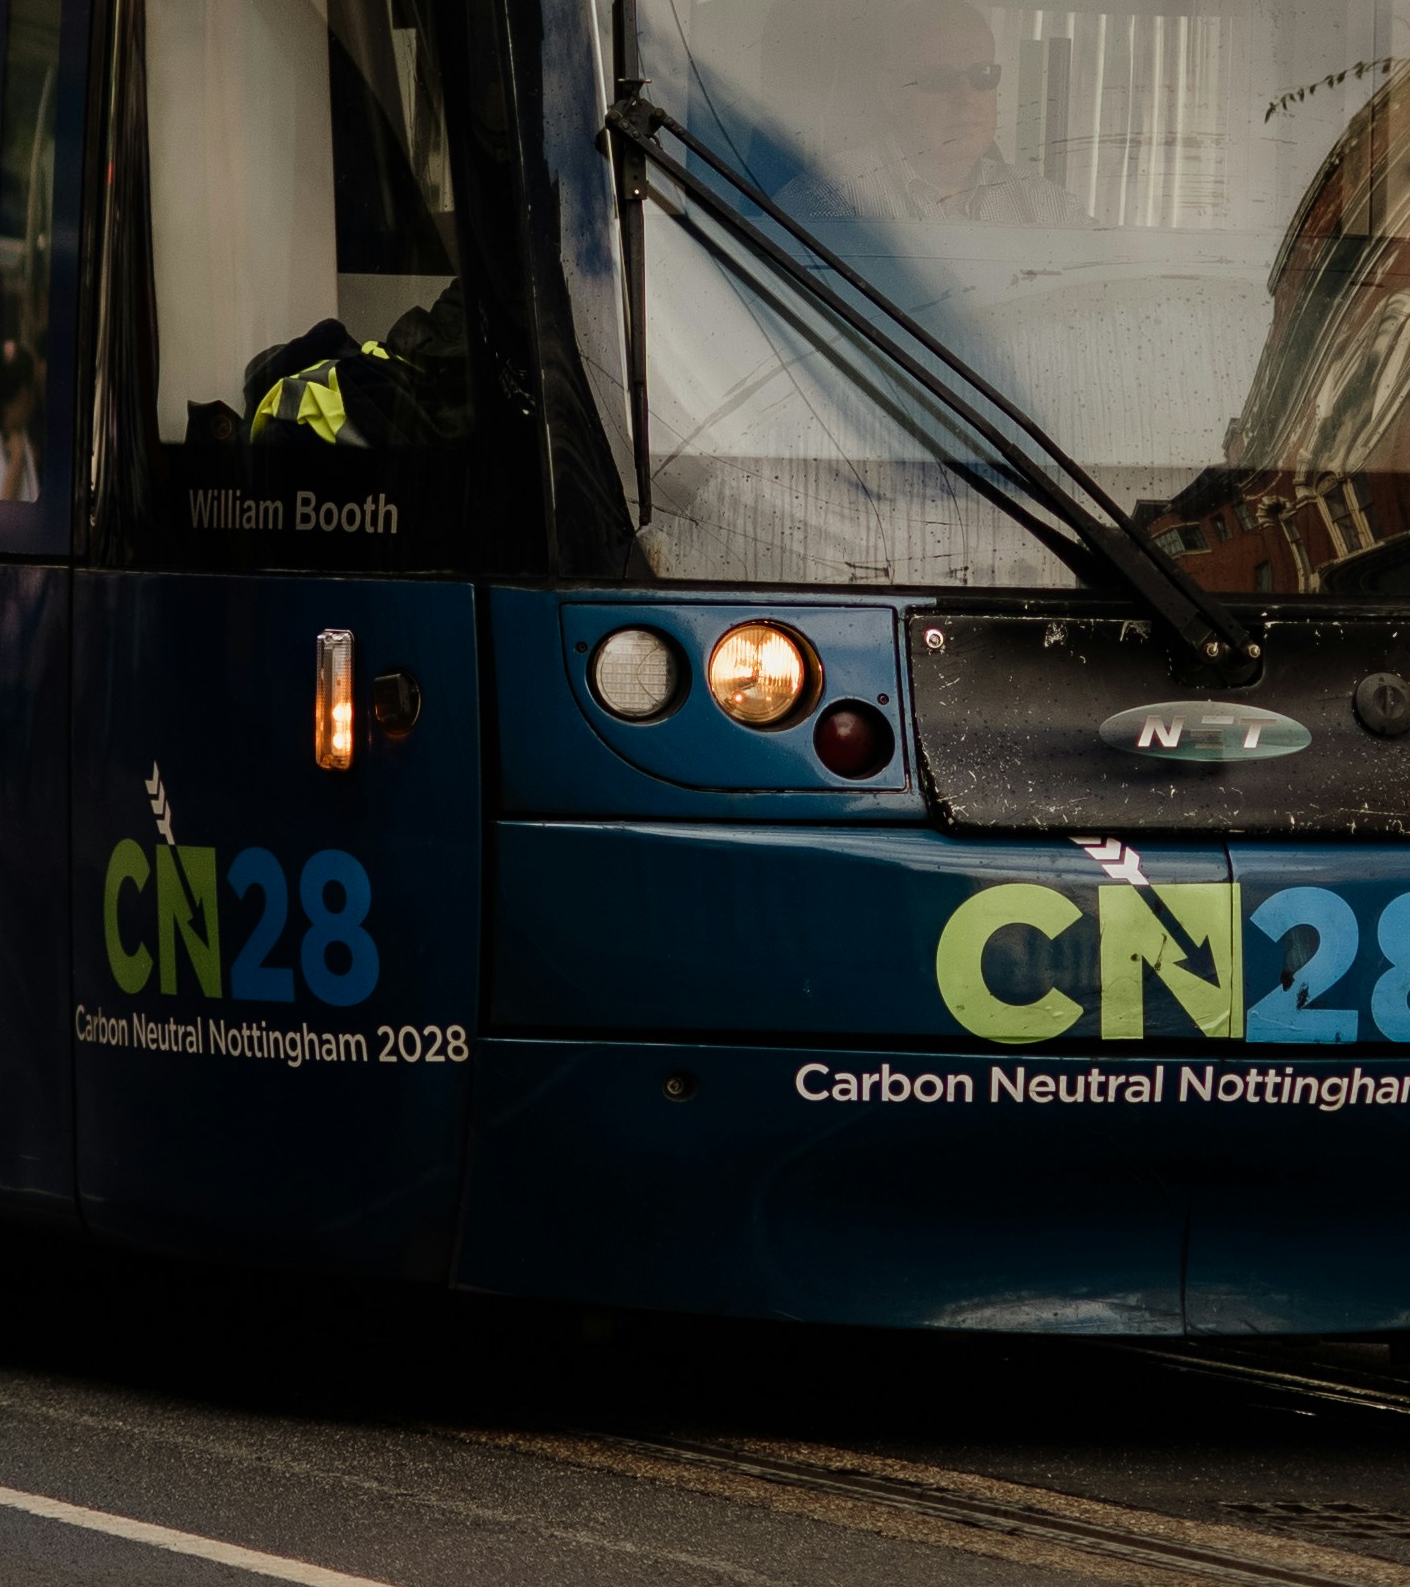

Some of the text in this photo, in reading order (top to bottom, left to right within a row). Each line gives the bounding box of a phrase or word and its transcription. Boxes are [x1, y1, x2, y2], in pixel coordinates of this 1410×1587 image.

[190, 489, 399, 535] William Booth
[1137, 715, 1278, 749] NET
[103, 838, 380, 1007] CN28
[75, 1003, 470, 1068] Carbon Neutral Nottingham 2028
[795, 1064, 974, 1105] Carbon
[990, 1065, 1164, 1105] Neutral
